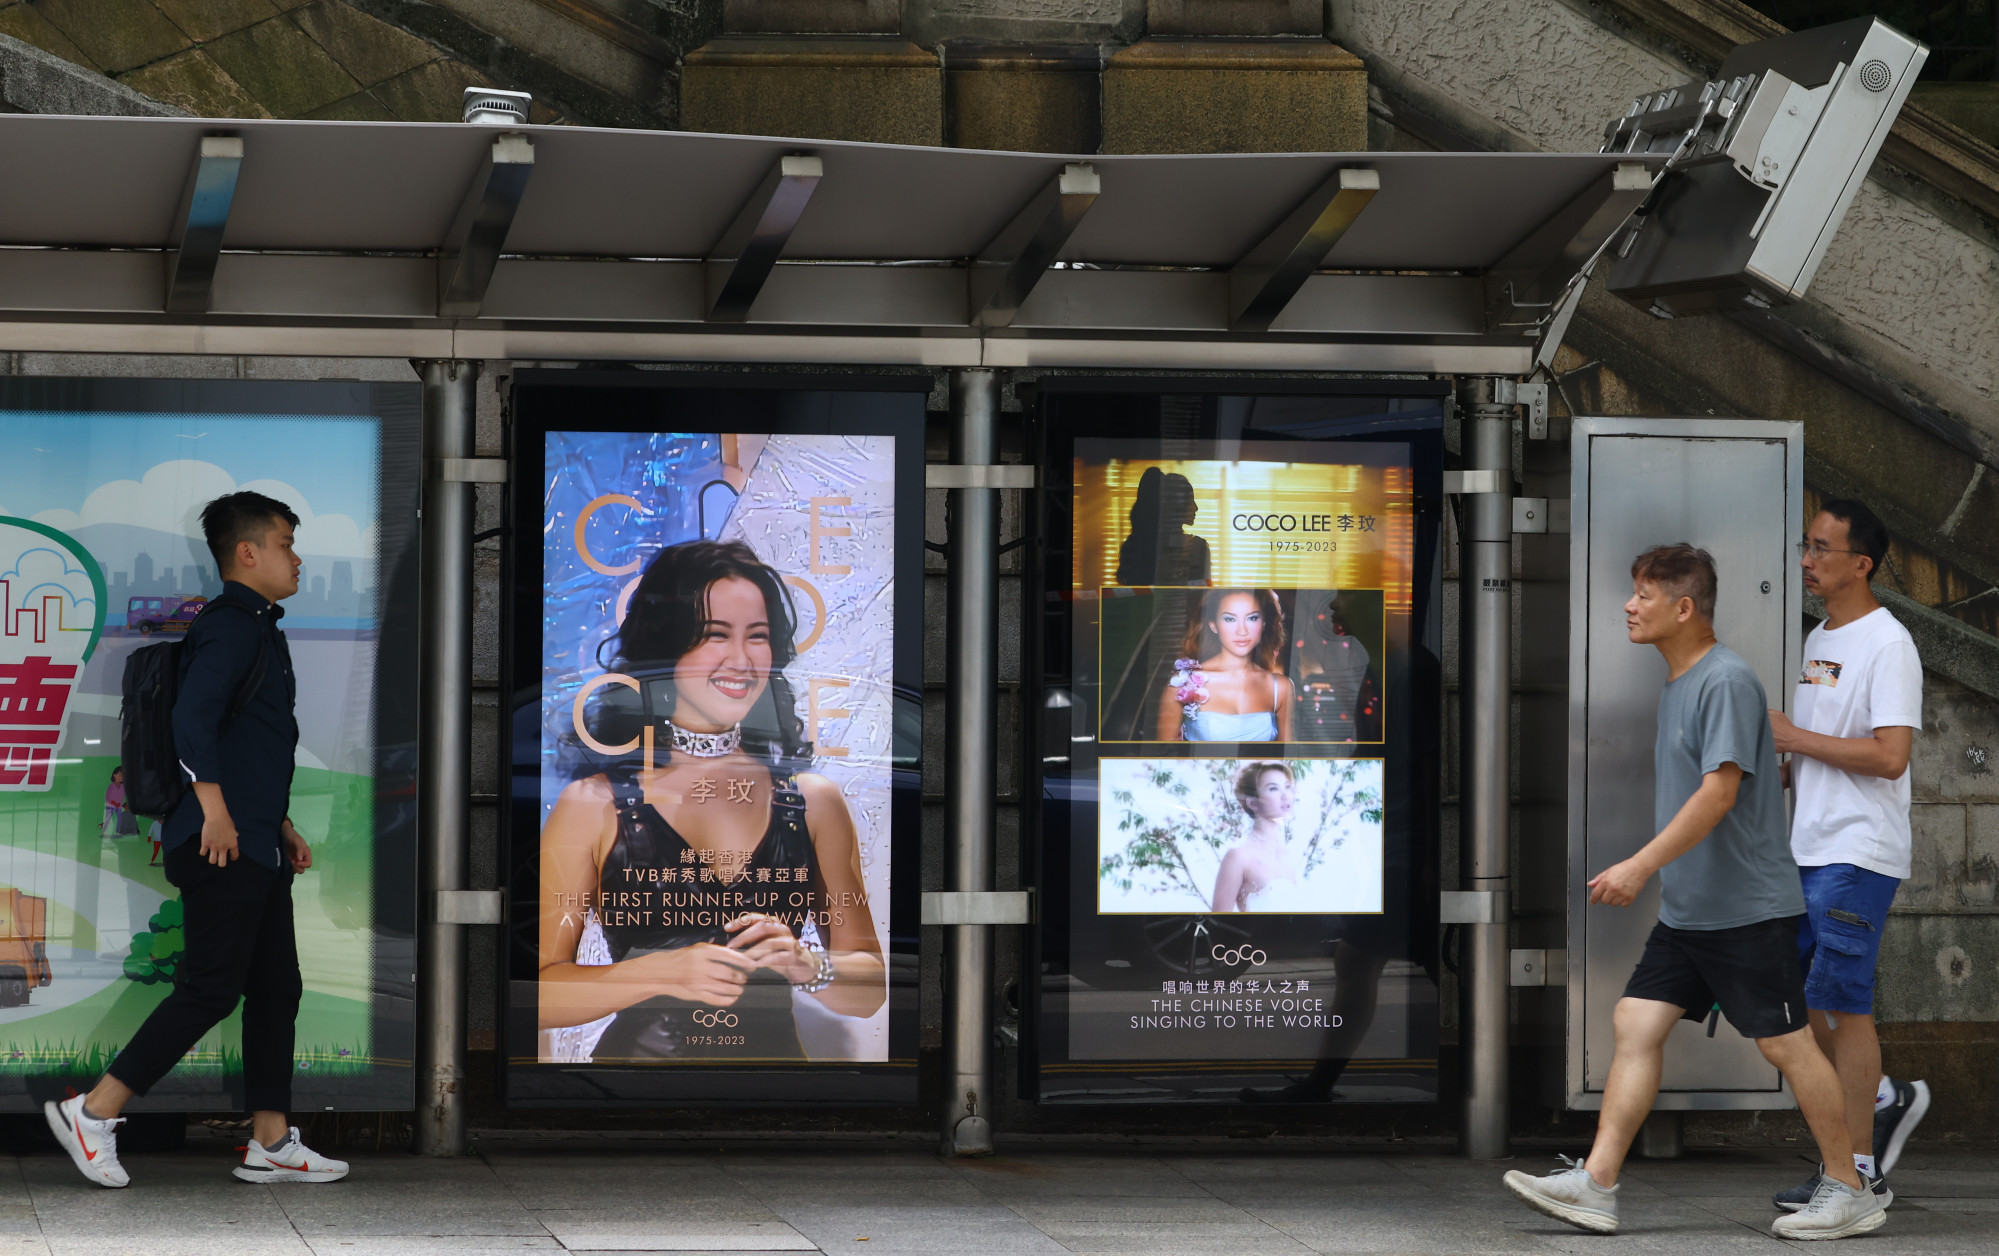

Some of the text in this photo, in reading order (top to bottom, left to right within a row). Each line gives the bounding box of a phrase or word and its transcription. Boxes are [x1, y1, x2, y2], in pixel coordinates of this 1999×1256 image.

[1232, 514, 1376, 533] COCO LEE 李玟
[1268, 541, 1338, 552] 1975-2023
[690, 777, 754, 804] 李玟
[680, 848, 753, 864] 緣起香港
[622, 867, 809, 883] TVB新秀歌唱大賽亞軍
[554, 892, 870, 908] THE FIRST RUNNER-UP OF NEW
[579, 911, 845, 927] TALENT SINGING AWARDS
[1162, 980, 1311, 995] 唱响世界的华人之声
[1152, 999, 1323, 1013] THE CHINESE VOICE
[1130, 1015, 1343, 1029] SINGING TO THE WORLD
[685, 1036, 745, 1045] 1975-2023
